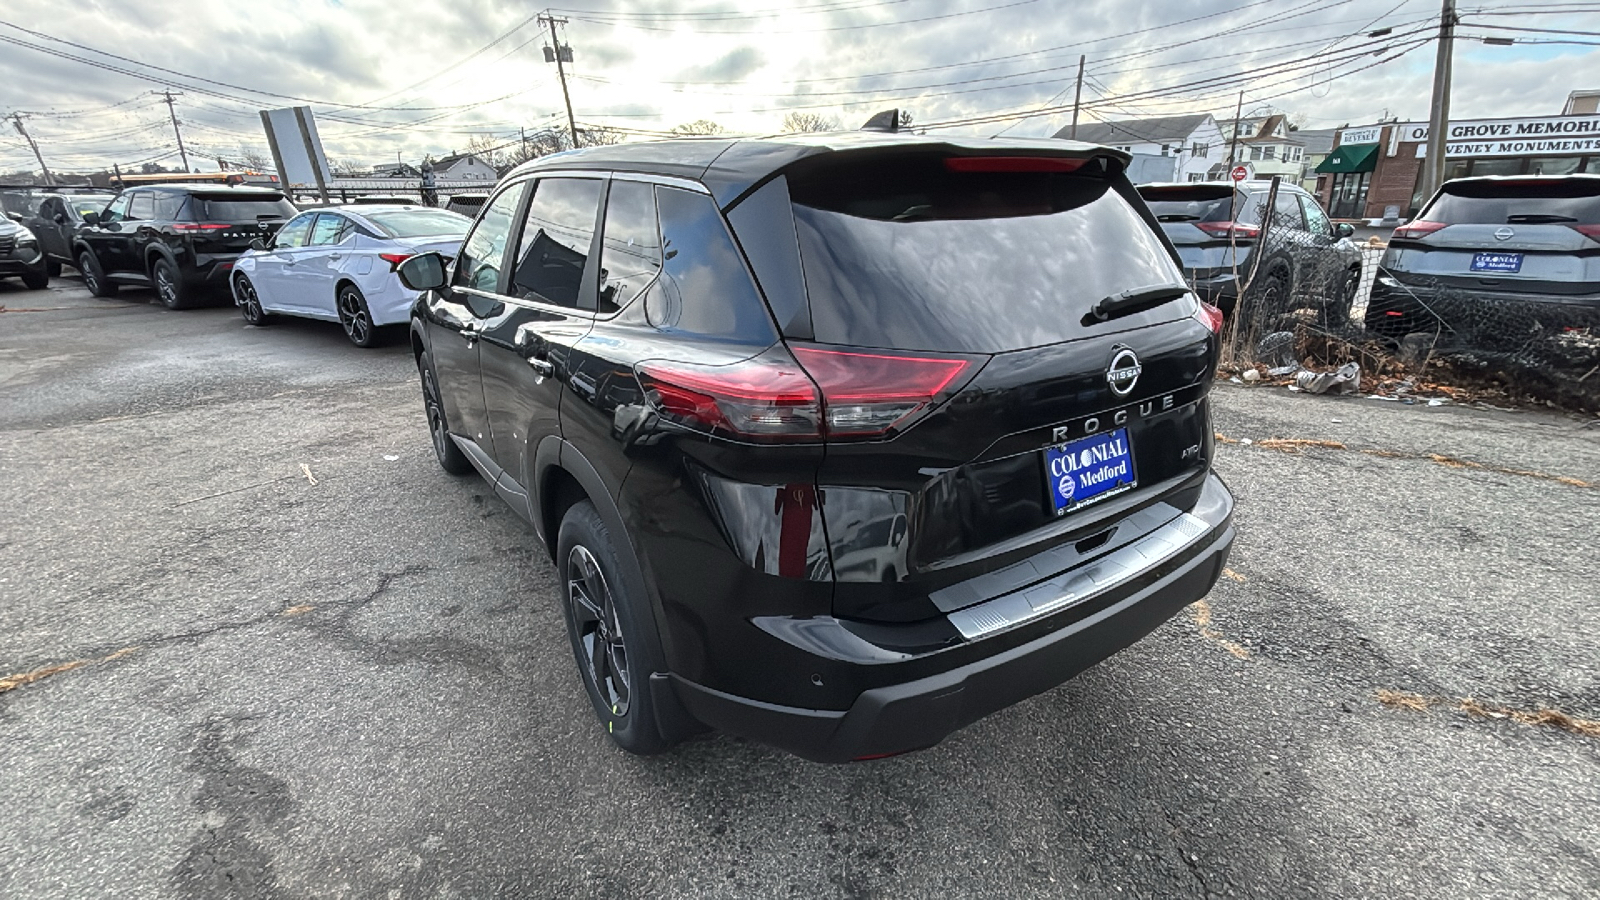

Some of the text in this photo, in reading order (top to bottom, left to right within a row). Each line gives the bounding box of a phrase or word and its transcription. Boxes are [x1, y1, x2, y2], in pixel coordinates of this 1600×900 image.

[1452, 124, 1512, 137] GROVE
[1515, 120, 1600, 134] MEMORI
[1498, 140, 1600, 153] MONUMENTS
[1107, 368, 1141, 381] NISSAN
[1052, 395, 1174, 443] ROGUE
[1051, 438, 1128, 478] COLONIAL
[1079, 460, 1127, 489] Medford
